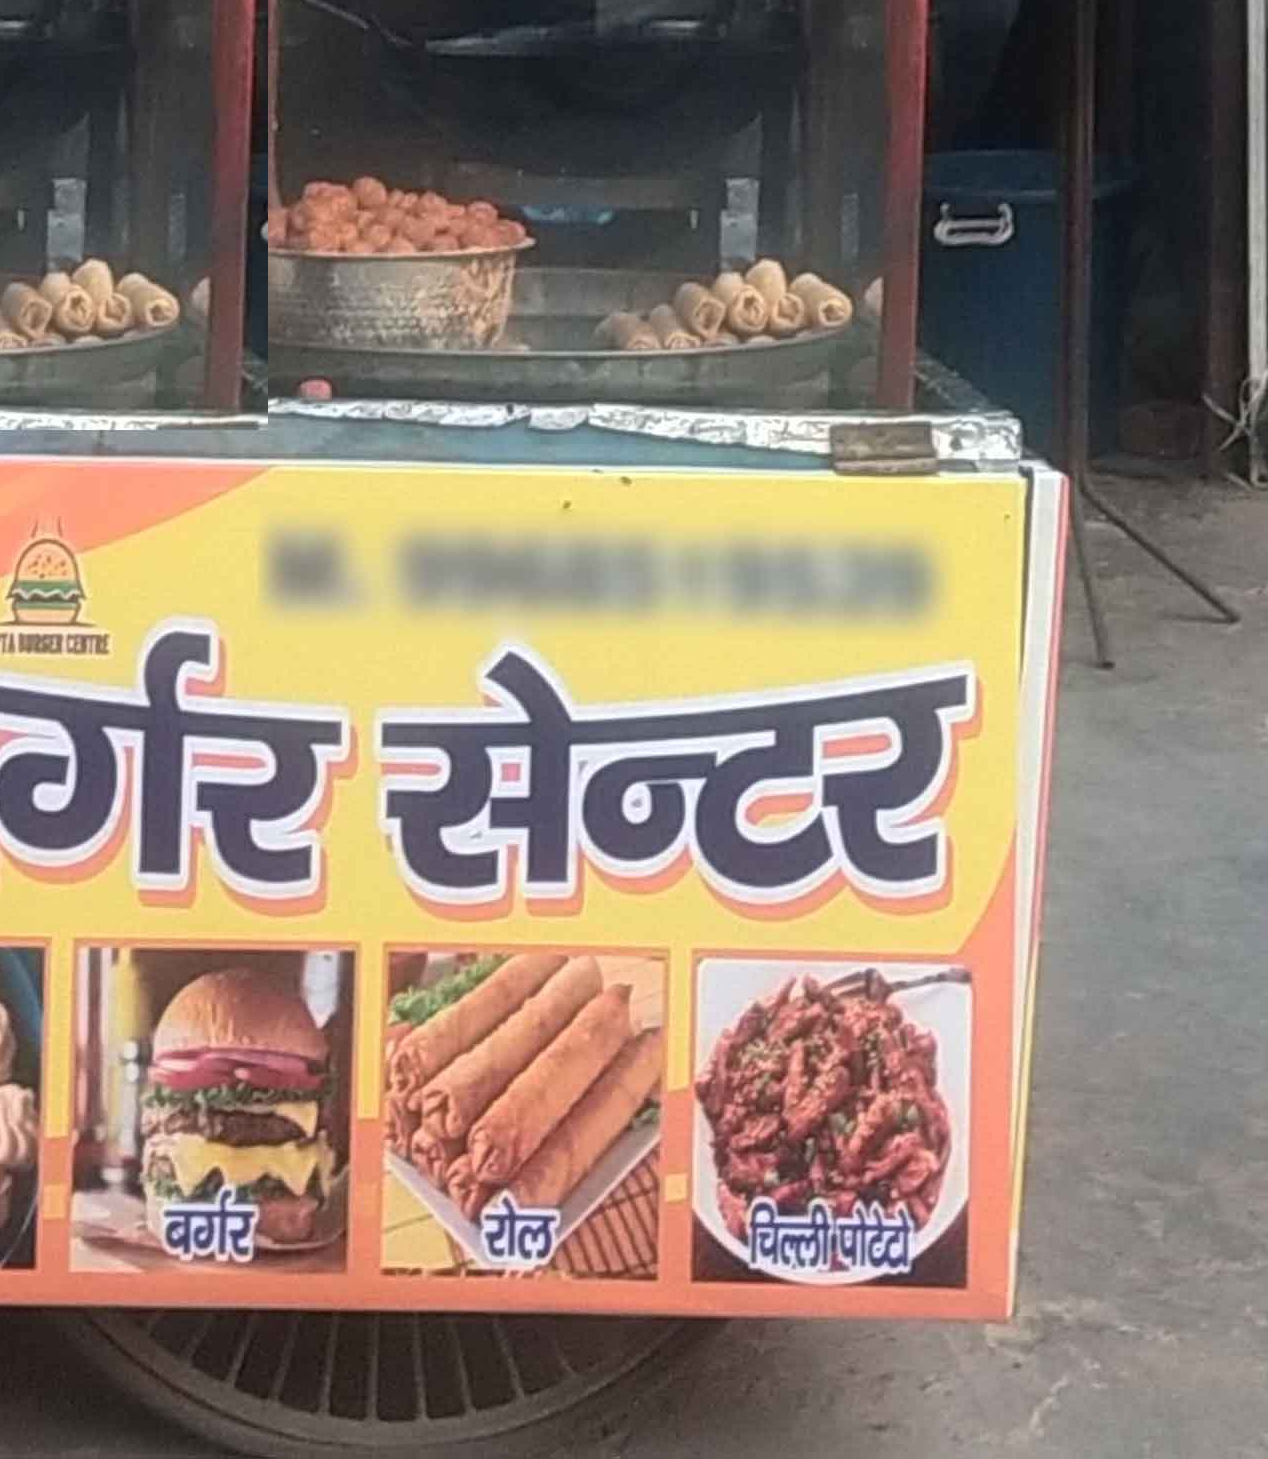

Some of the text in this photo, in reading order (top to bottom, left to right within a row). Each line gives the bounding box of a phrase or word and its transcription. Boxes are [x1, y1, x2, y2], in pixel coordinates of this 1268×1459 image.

[17, 632, 64, 655] BURGER
[65, 633, 111, 655] CENTRE
[382, 650, 969, 889] सेन्टर
[163, 1189, 254, 1255] बर्गर
[484, 1195, 557, 1259] रोल
[750, 1202, 830, 1267] चिल्ली
